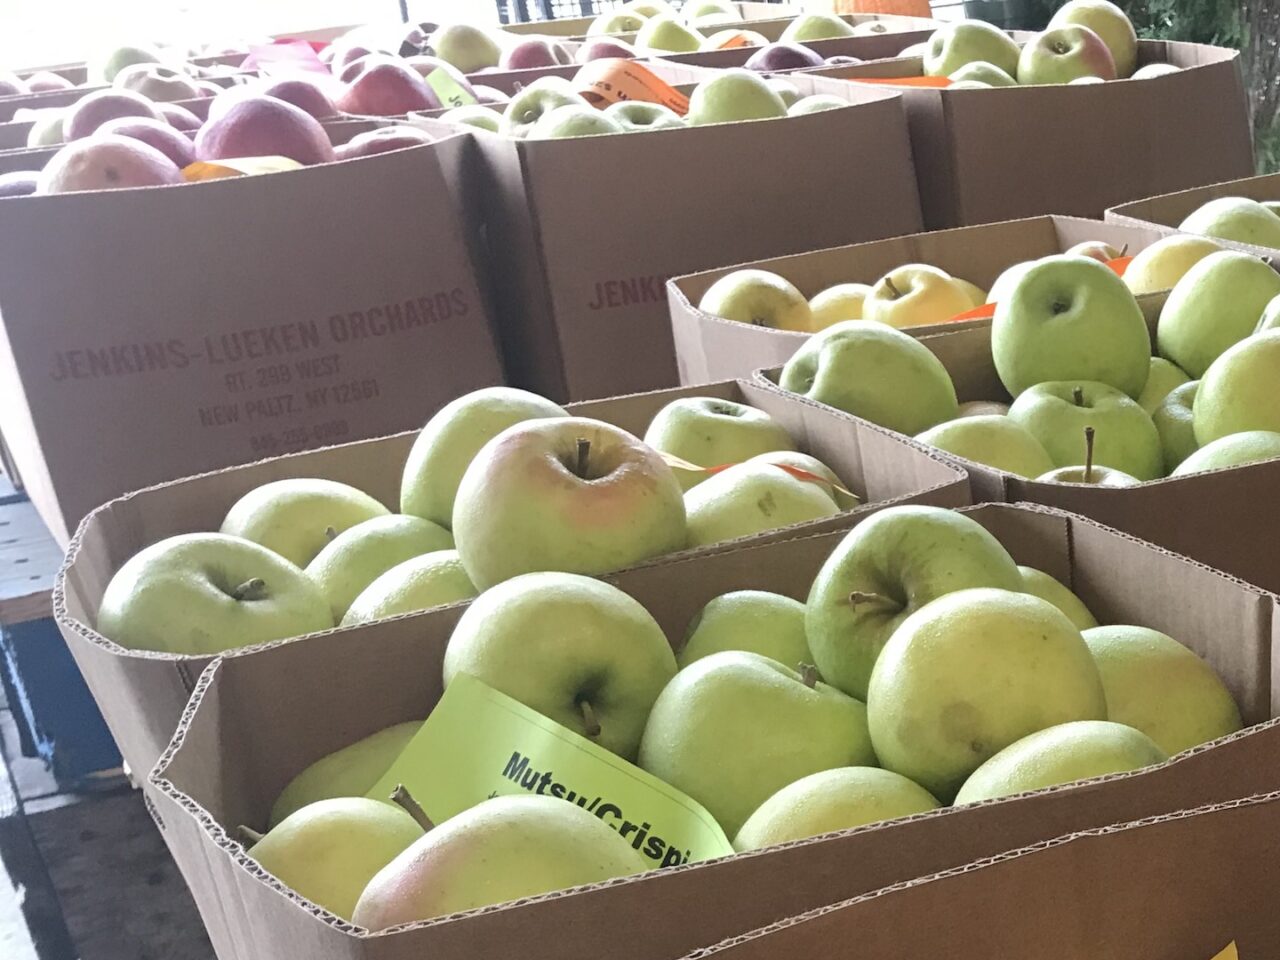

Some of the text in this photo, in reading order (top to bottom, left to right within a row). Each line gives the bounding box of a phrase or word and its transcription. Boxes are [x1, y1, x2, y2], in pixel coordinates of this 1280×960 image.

[51, 288, 470, 382] JENKINS-LUEKEN ORCHARDS
[295, 354, 341, 380] WEST
[198, 403, 239, 427] NEW
[305, 386, 329, 410] NY
